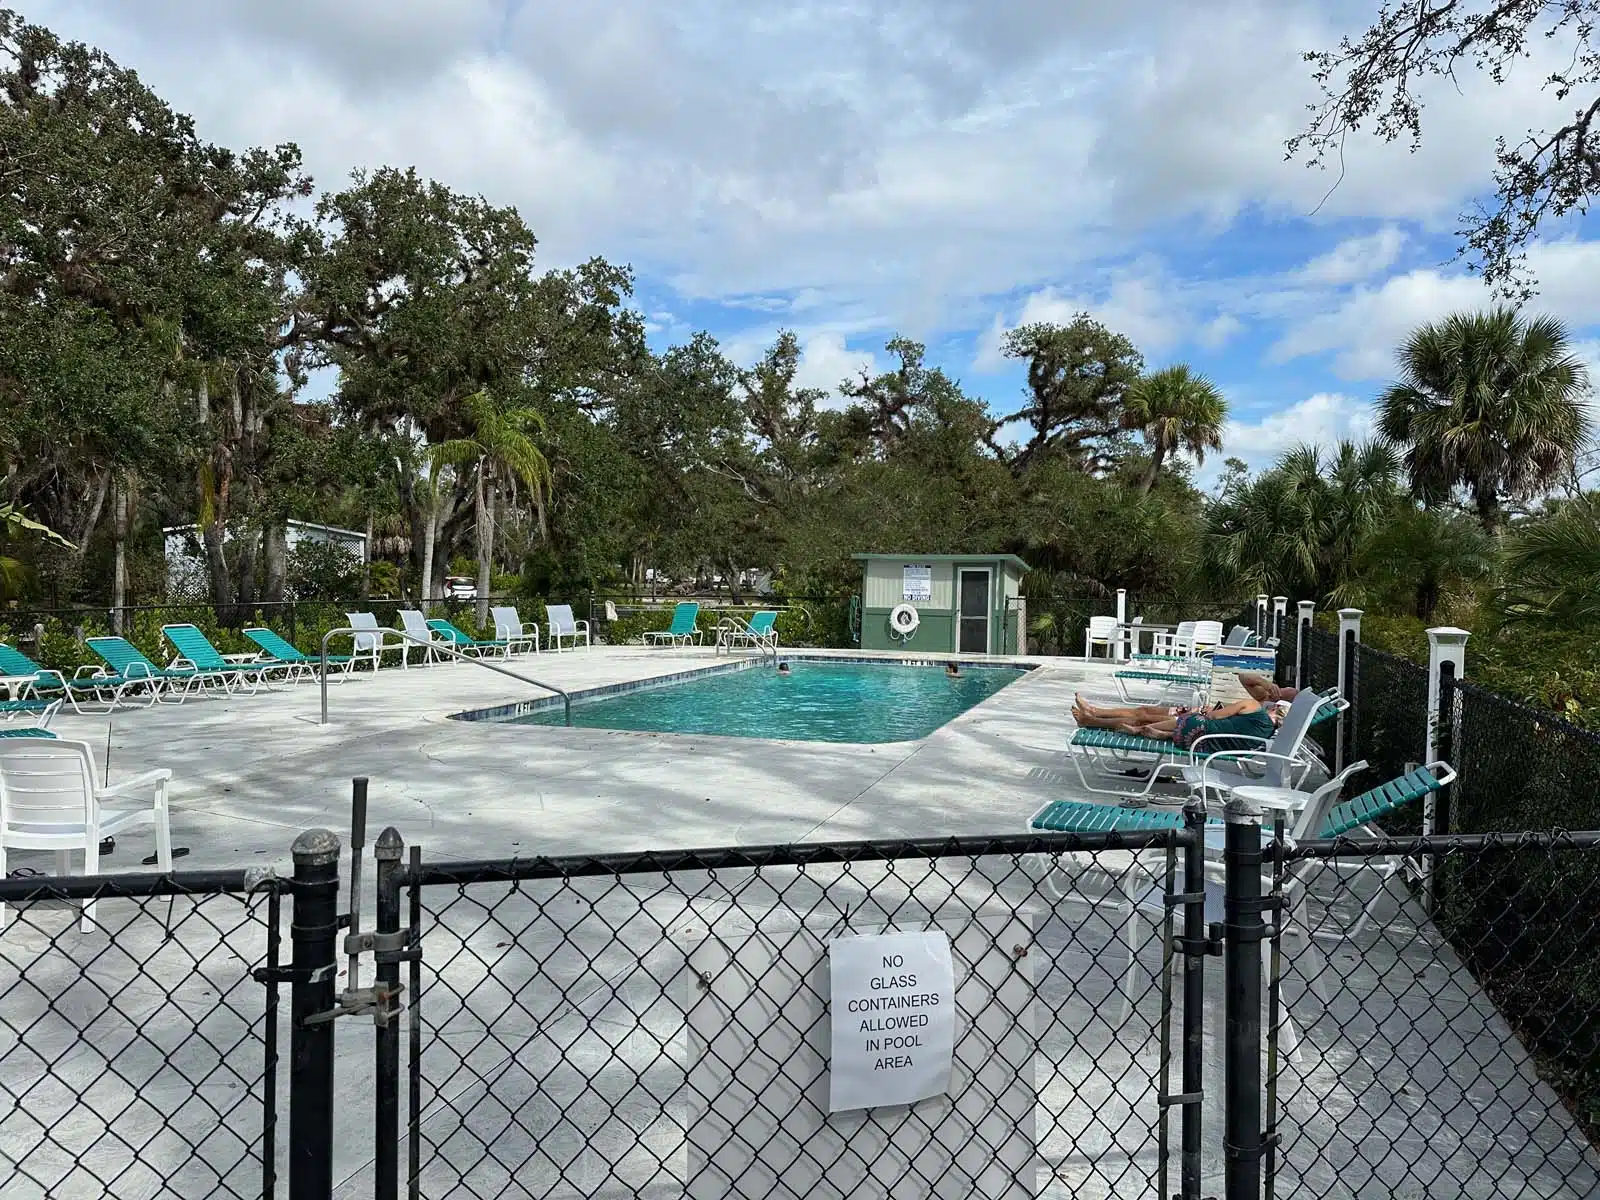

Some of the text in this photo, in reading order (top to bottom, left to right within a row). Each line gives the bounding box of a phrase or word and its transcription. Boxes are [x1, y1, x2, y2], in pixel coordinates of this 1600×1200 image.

[883, 955, 904, 968] NO
[870, 975, 917, 990] GLASS
[848, 993, 939, 1012] CONTAINERS
[859, 1014, 928, 1032] ALLOWED
[866, 1035, 923, 1052] IN POOL
[874, 1055, 913, 1071] AREA
